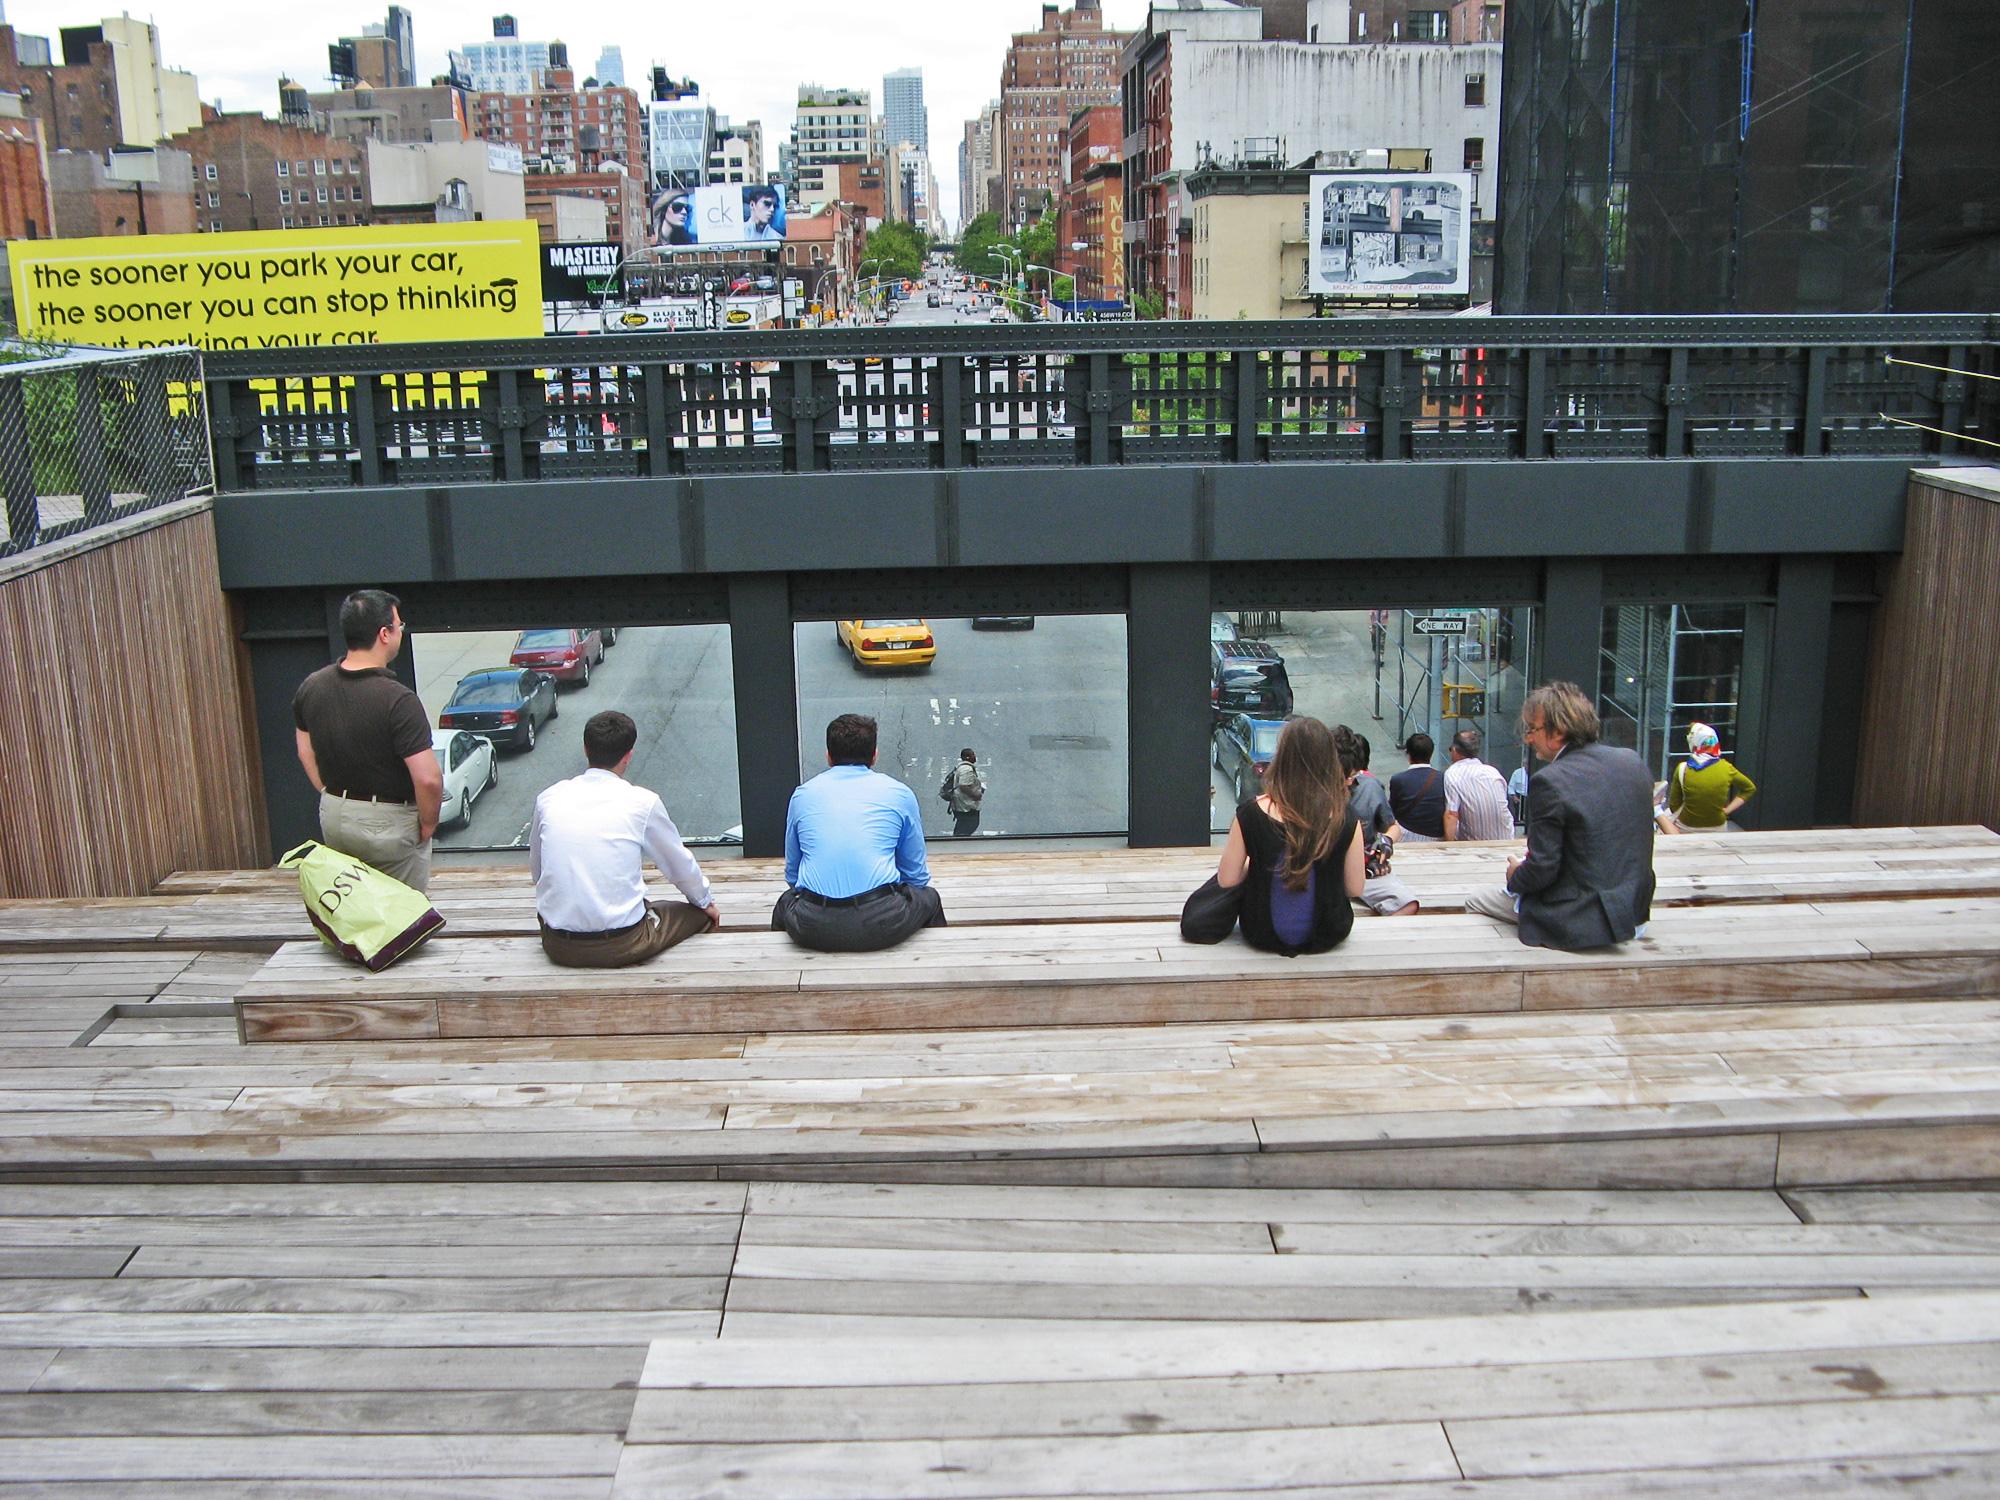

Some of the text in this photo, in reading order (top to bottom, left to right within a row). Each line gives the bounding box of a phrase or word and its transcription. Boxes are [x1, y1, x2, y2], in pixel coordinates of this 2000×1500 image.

[707, 195, 733, 223] ck
[33, 252, 463, 288] the sooner you park your car,
[549, 247, 619, 266] MASTERY
[567, 265, 617, 276] NOT MIMICRY
[38, 284, 518, 326] the sooner you can stop thinking
[705, 291, 715, 327] PARK
[138, 332, 248, 350] arking
[319, 861, 370, 916] DSW
